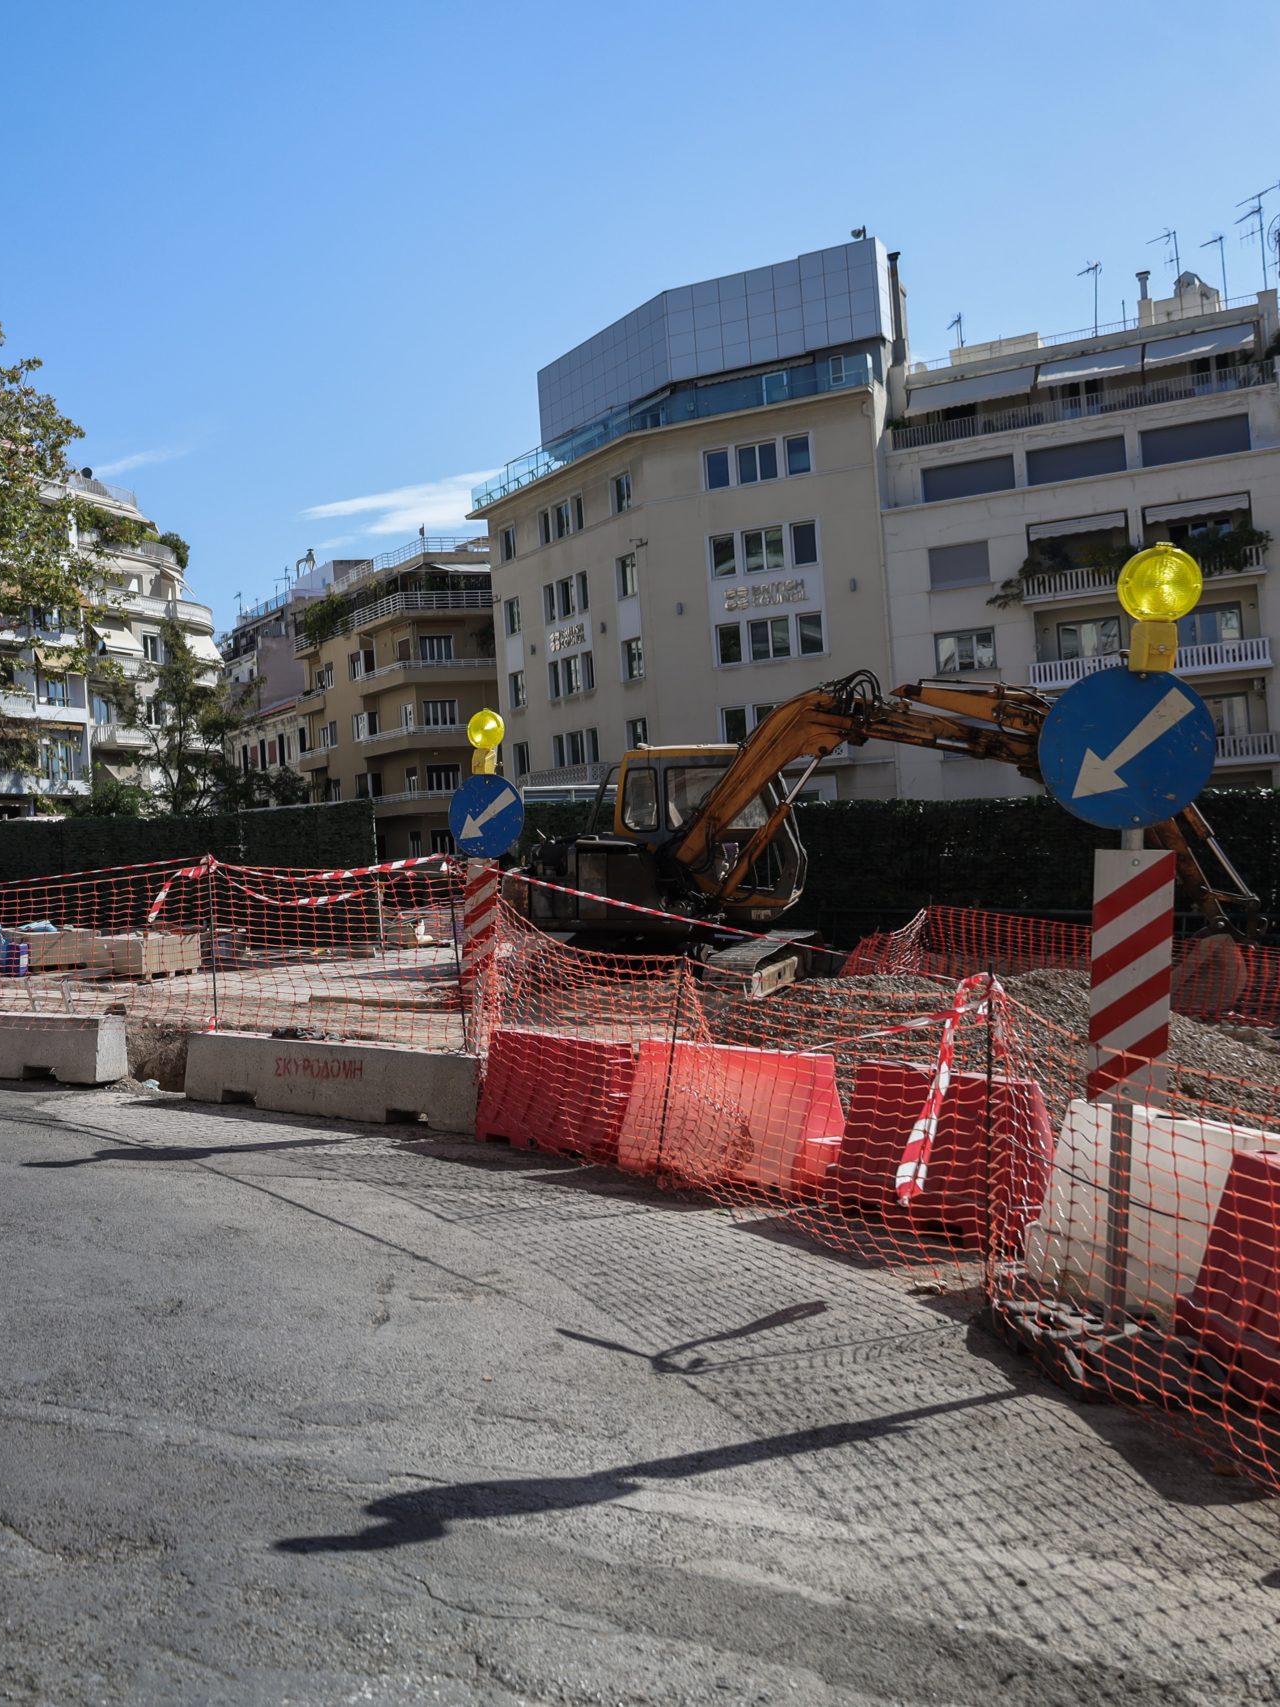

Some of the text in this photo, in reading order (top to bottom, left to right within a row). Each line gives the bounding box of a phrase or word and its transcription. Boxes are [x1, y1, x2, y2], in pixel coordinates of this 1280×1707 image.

[751, 579, 805, 595] BRITISH
[752, 588, 808, 608] COUNCIL
[274, 1057, 363, 1079] ΣΚΥΡΟΔΟΜΗ
